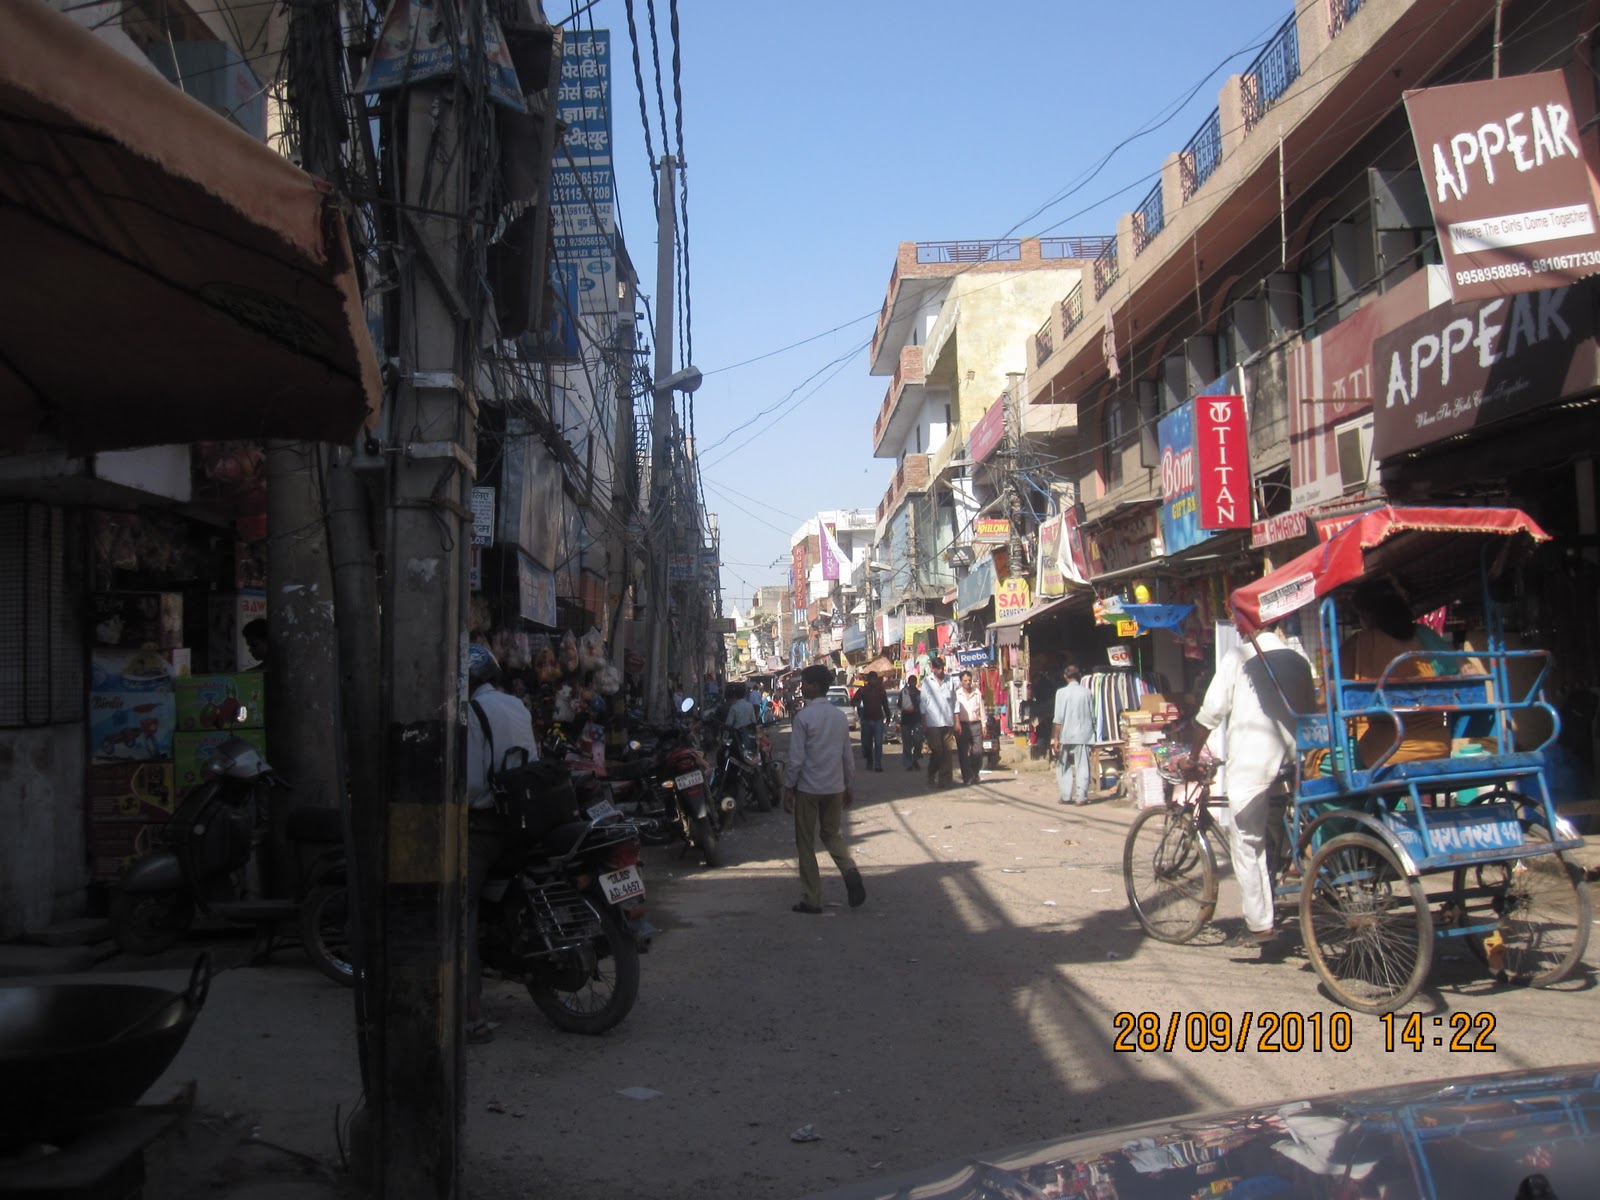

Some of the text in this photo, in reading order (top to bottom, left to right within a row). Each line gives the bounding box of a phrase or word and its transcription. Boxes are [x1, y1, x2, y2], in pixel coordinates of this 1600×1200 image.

[1432, 103, 1579, 202] APPEAR
[553, 186, 610, 201] 921157208
[1453, 210, 1588, 241] Where The Girls Come Together
[1455, 262, 1532, 285] 9958958895,
[1386, 287, 1571, 408] APPEAR
[1415, 411, 1435, 429] Where
[1436, 403, 1451, 421] The
[1453, 396, 1472, 418] Girls
[1161, 449, 1194, 500] Bom
[1211, 427, 1235, 524] TITAN
[1172, 499, 1187, 520] GIFT
[960, 652, 989, 663] Reebo
